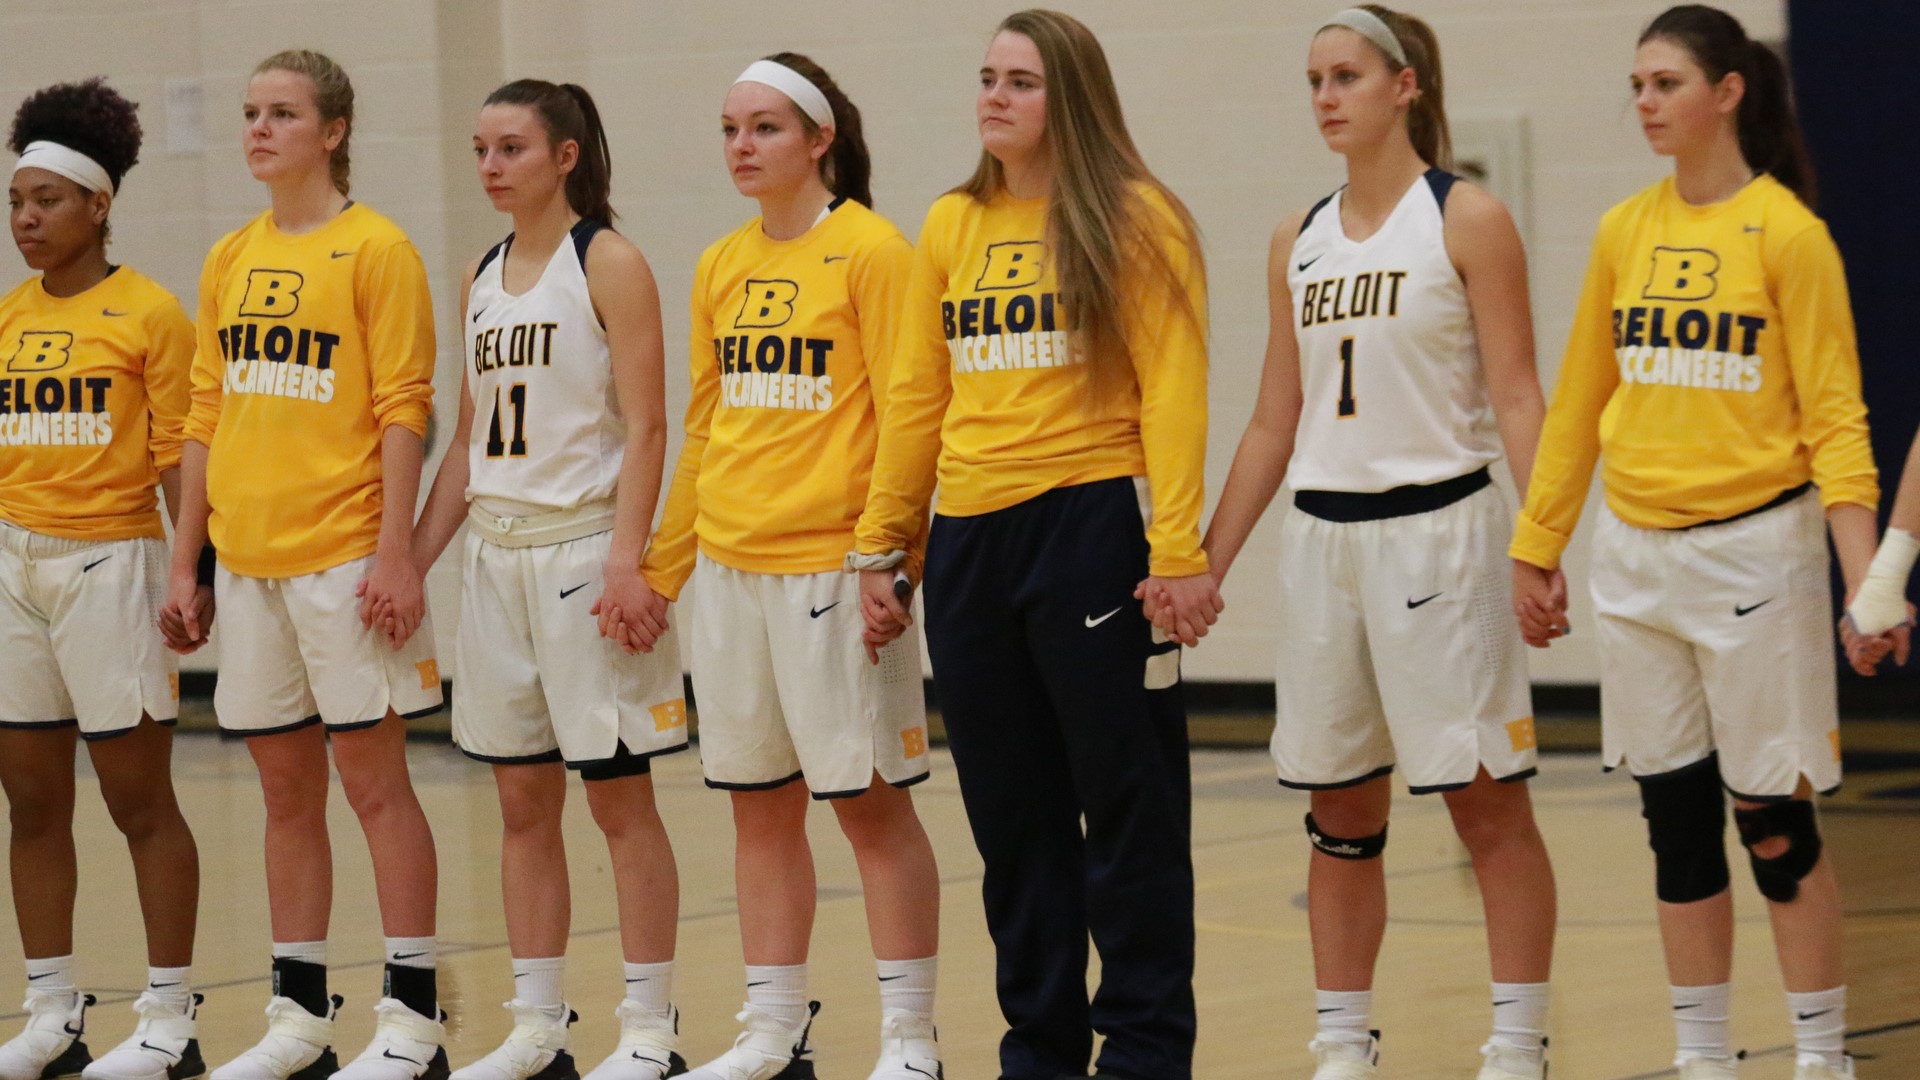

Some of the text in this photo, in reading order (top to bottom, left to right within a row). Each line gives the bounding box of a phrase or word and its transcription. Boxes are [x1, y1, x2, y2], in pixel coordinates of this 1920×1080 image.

[239, 268, 304, 318] B
[1301, 270, 1408, 328] BELOIT
[1641, 246, 1721, 301] B
[734, 279, 799, 329] B
[7, 331, 73, 373] B
[475, 322, 558, 376] BELOIT
[0, 377, 112, 414] ELOIT
[1337, 335, 1357, 420] 1
[0, 411, 113, 445] CCANEERS
[486, 382, 528, 459] 11
